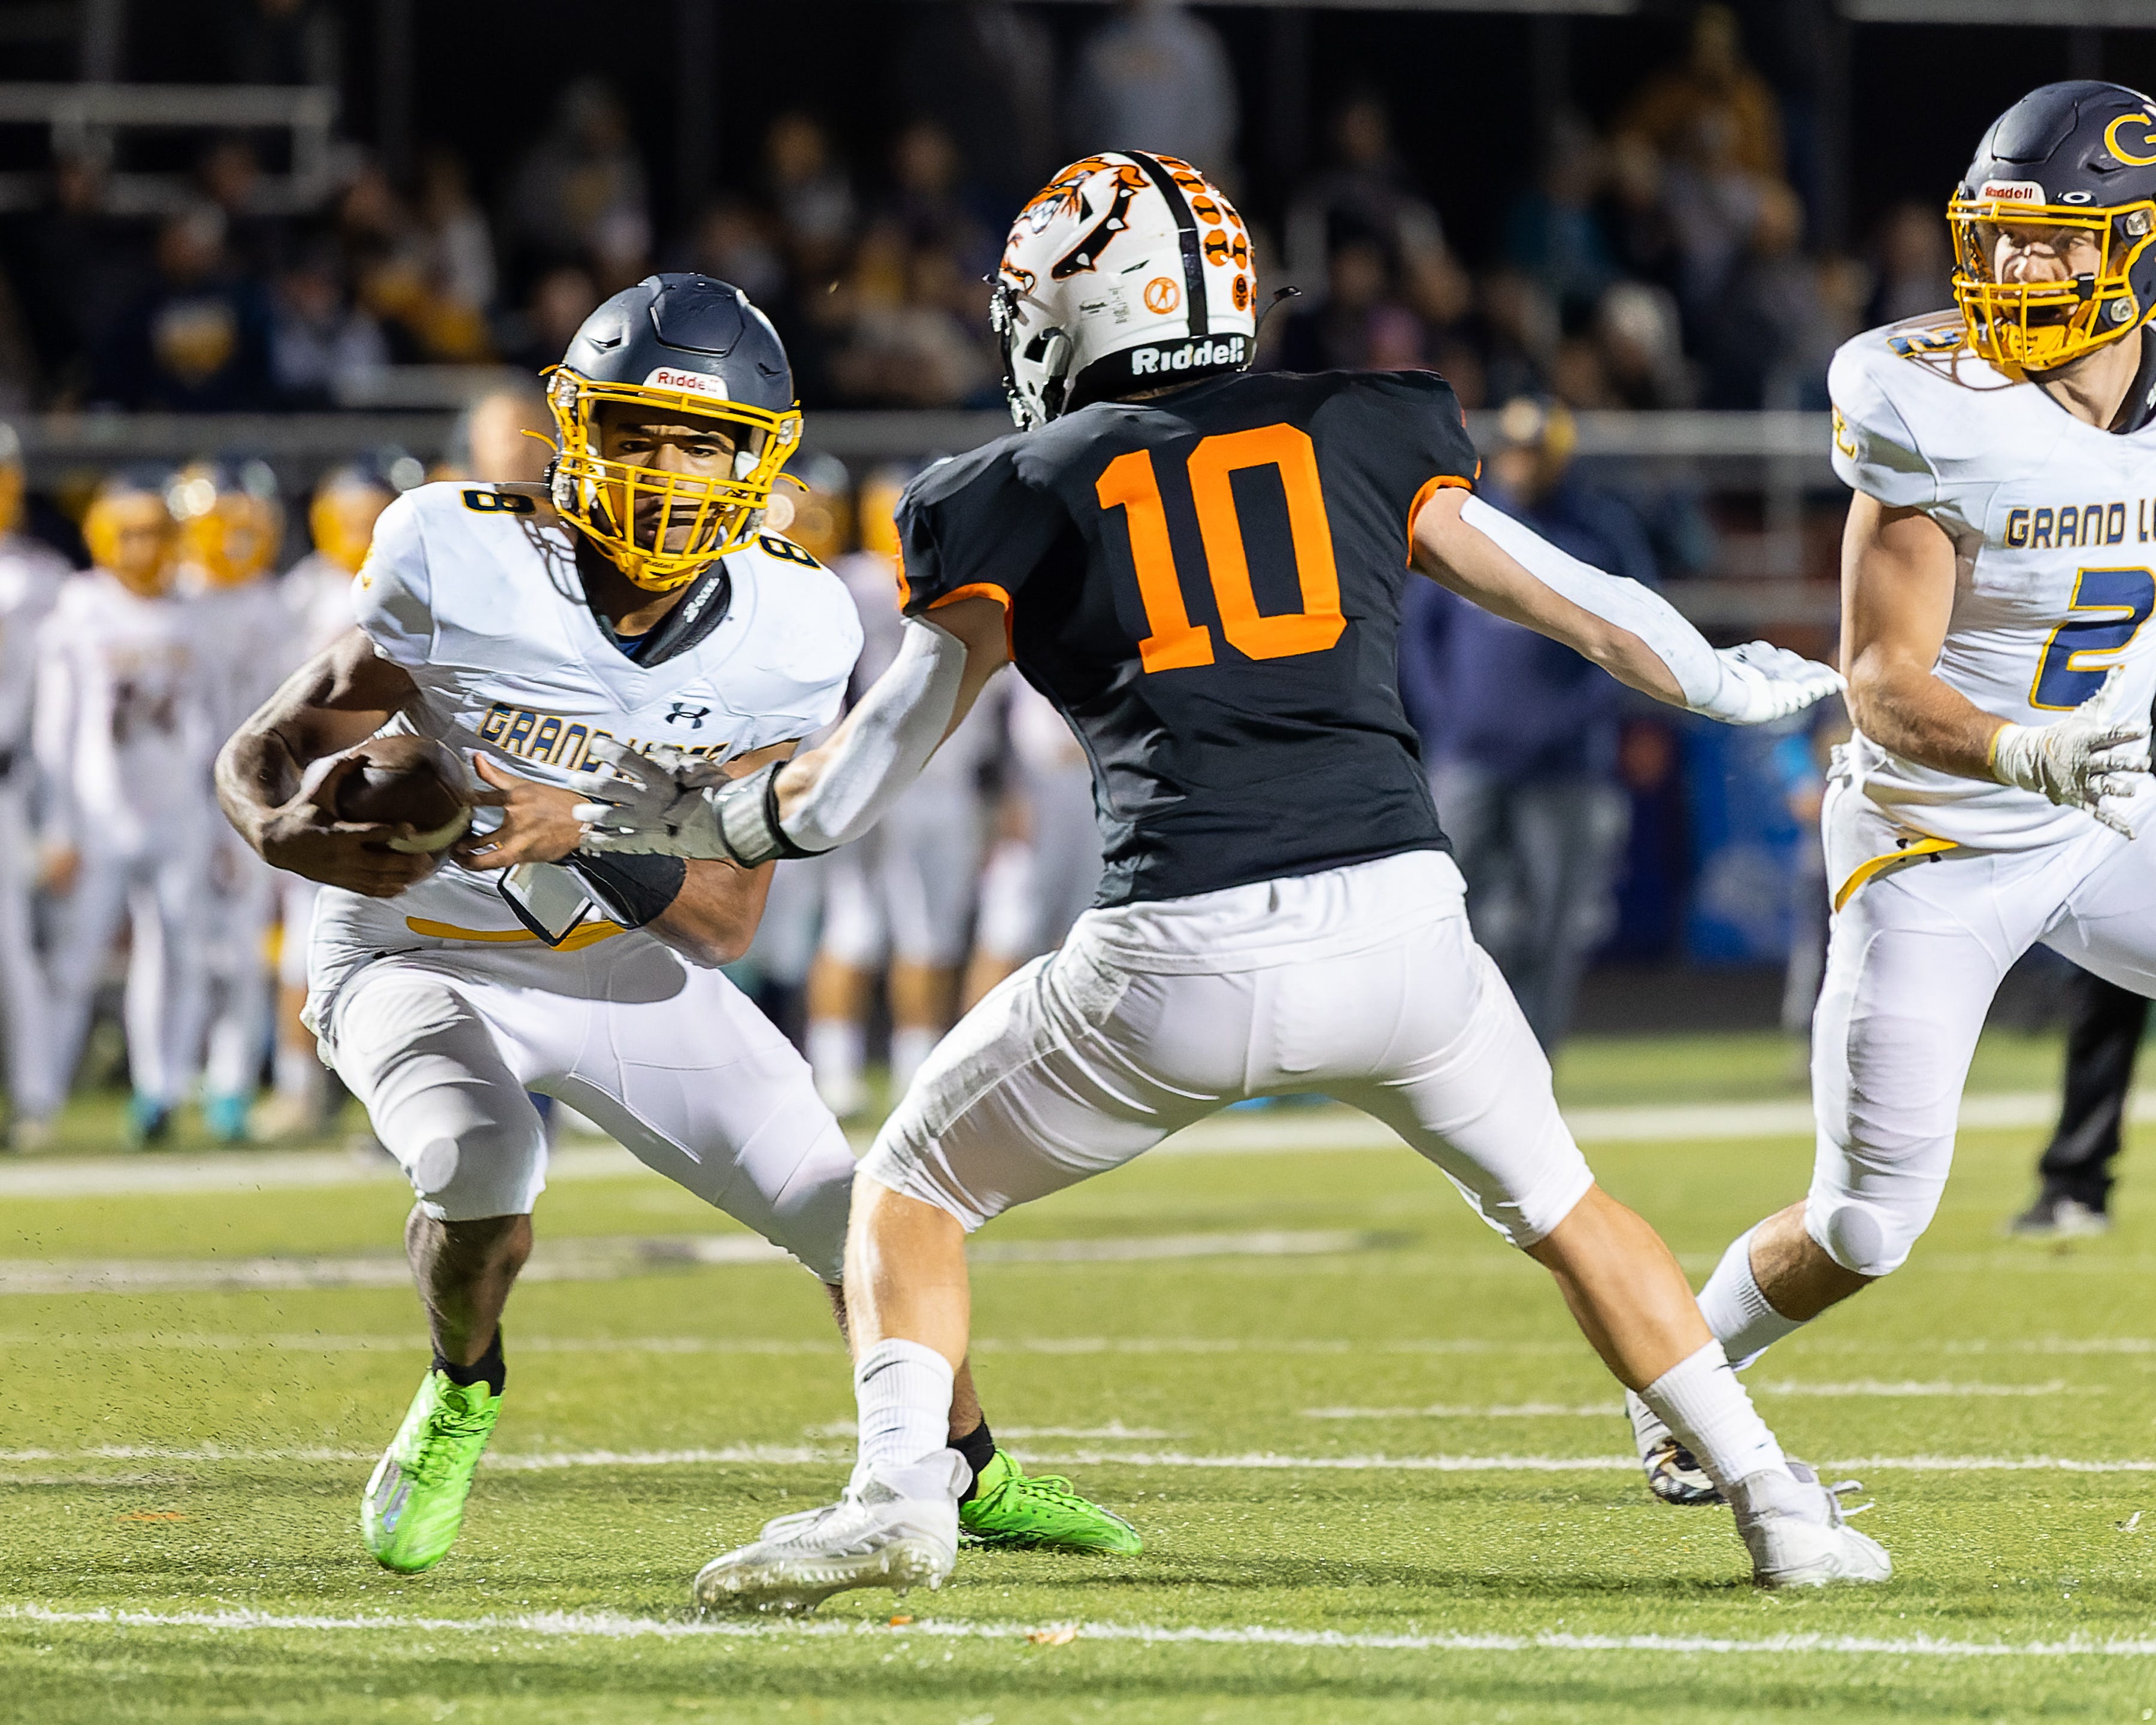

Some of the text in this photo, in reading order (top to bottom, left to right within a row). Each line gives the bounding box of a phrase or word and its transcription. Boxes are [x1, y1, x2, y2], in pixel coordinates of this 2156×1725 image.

[1131, 336, 1245, 375] Riddell
[459, 488, 538, 516] 8
[2004, 501, 2127, 549] GRAND
[757, 532, 822, 571] 8
[1095, 422, 1348, 674] 10
[2028, 566, 2156, 711] 2
